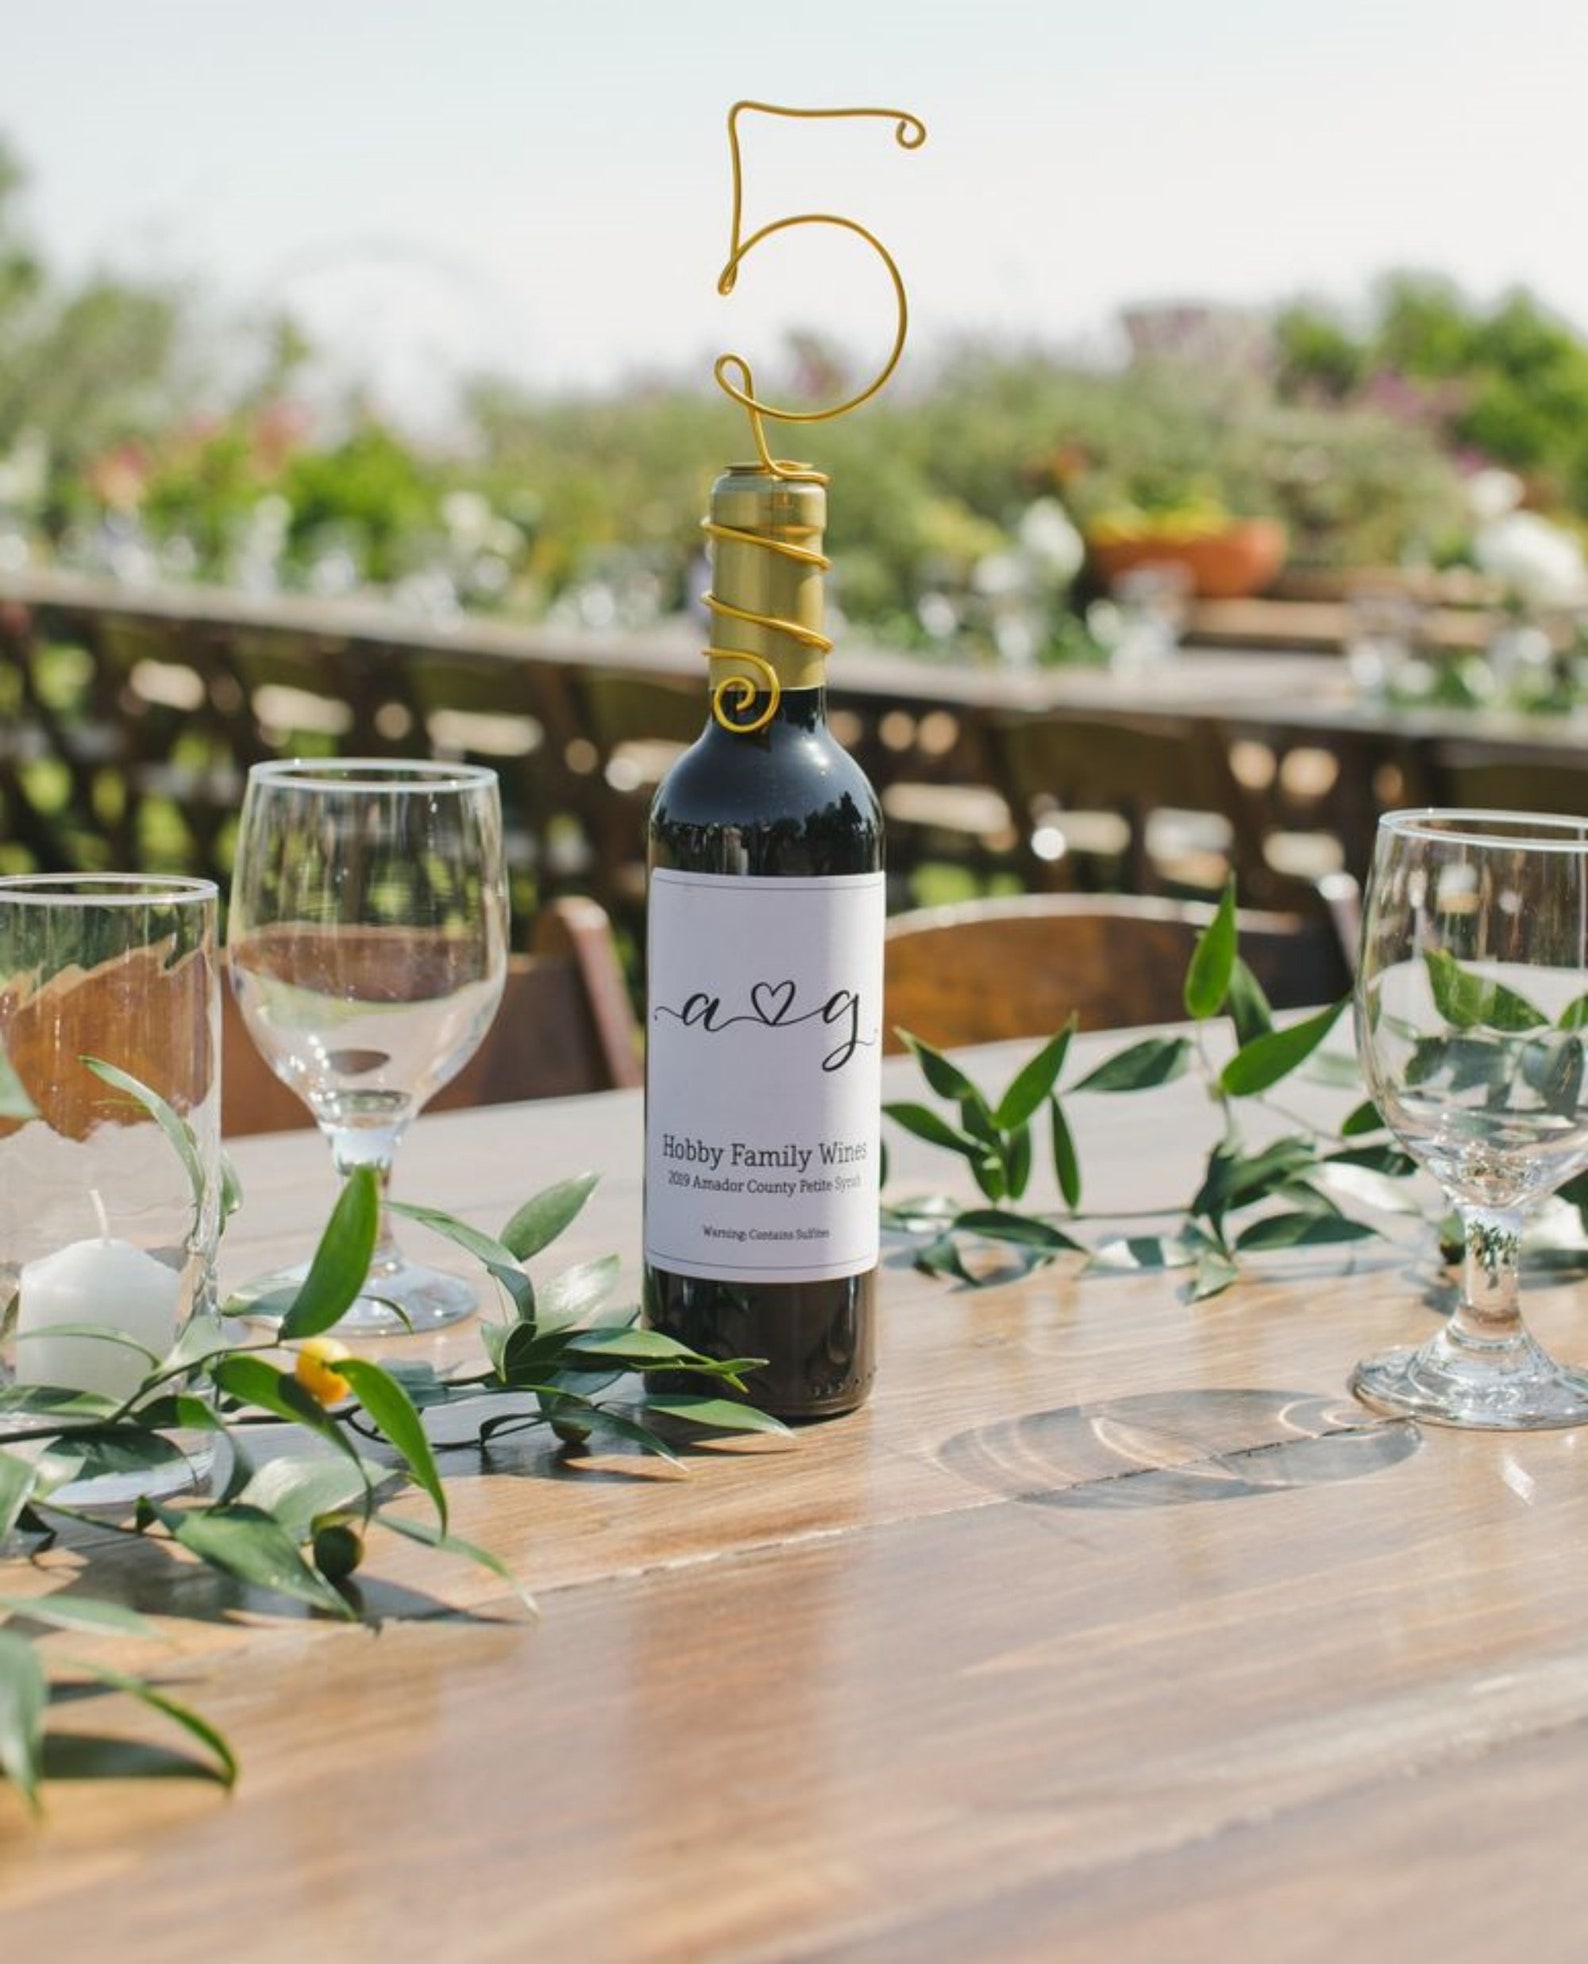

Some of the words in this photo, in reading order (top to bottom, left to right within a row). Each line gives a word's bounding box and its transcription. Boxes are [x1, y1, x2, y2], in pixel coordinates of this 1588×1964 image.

[715, 100, 926, 423] 5
[662, 1134, 724, 1170] Hobby
[731, 1143, 813, 1173] Family
[818, 1141, 868, 1165] Wines
[668, 1171, 690, 1187] 2019
[693, 1175, 743, 1193] Amador
[747, 1179, 796, 1198] County
[800, 1178, 833, 1194] Petite
[749, 1228, 794, 1240] Contains
